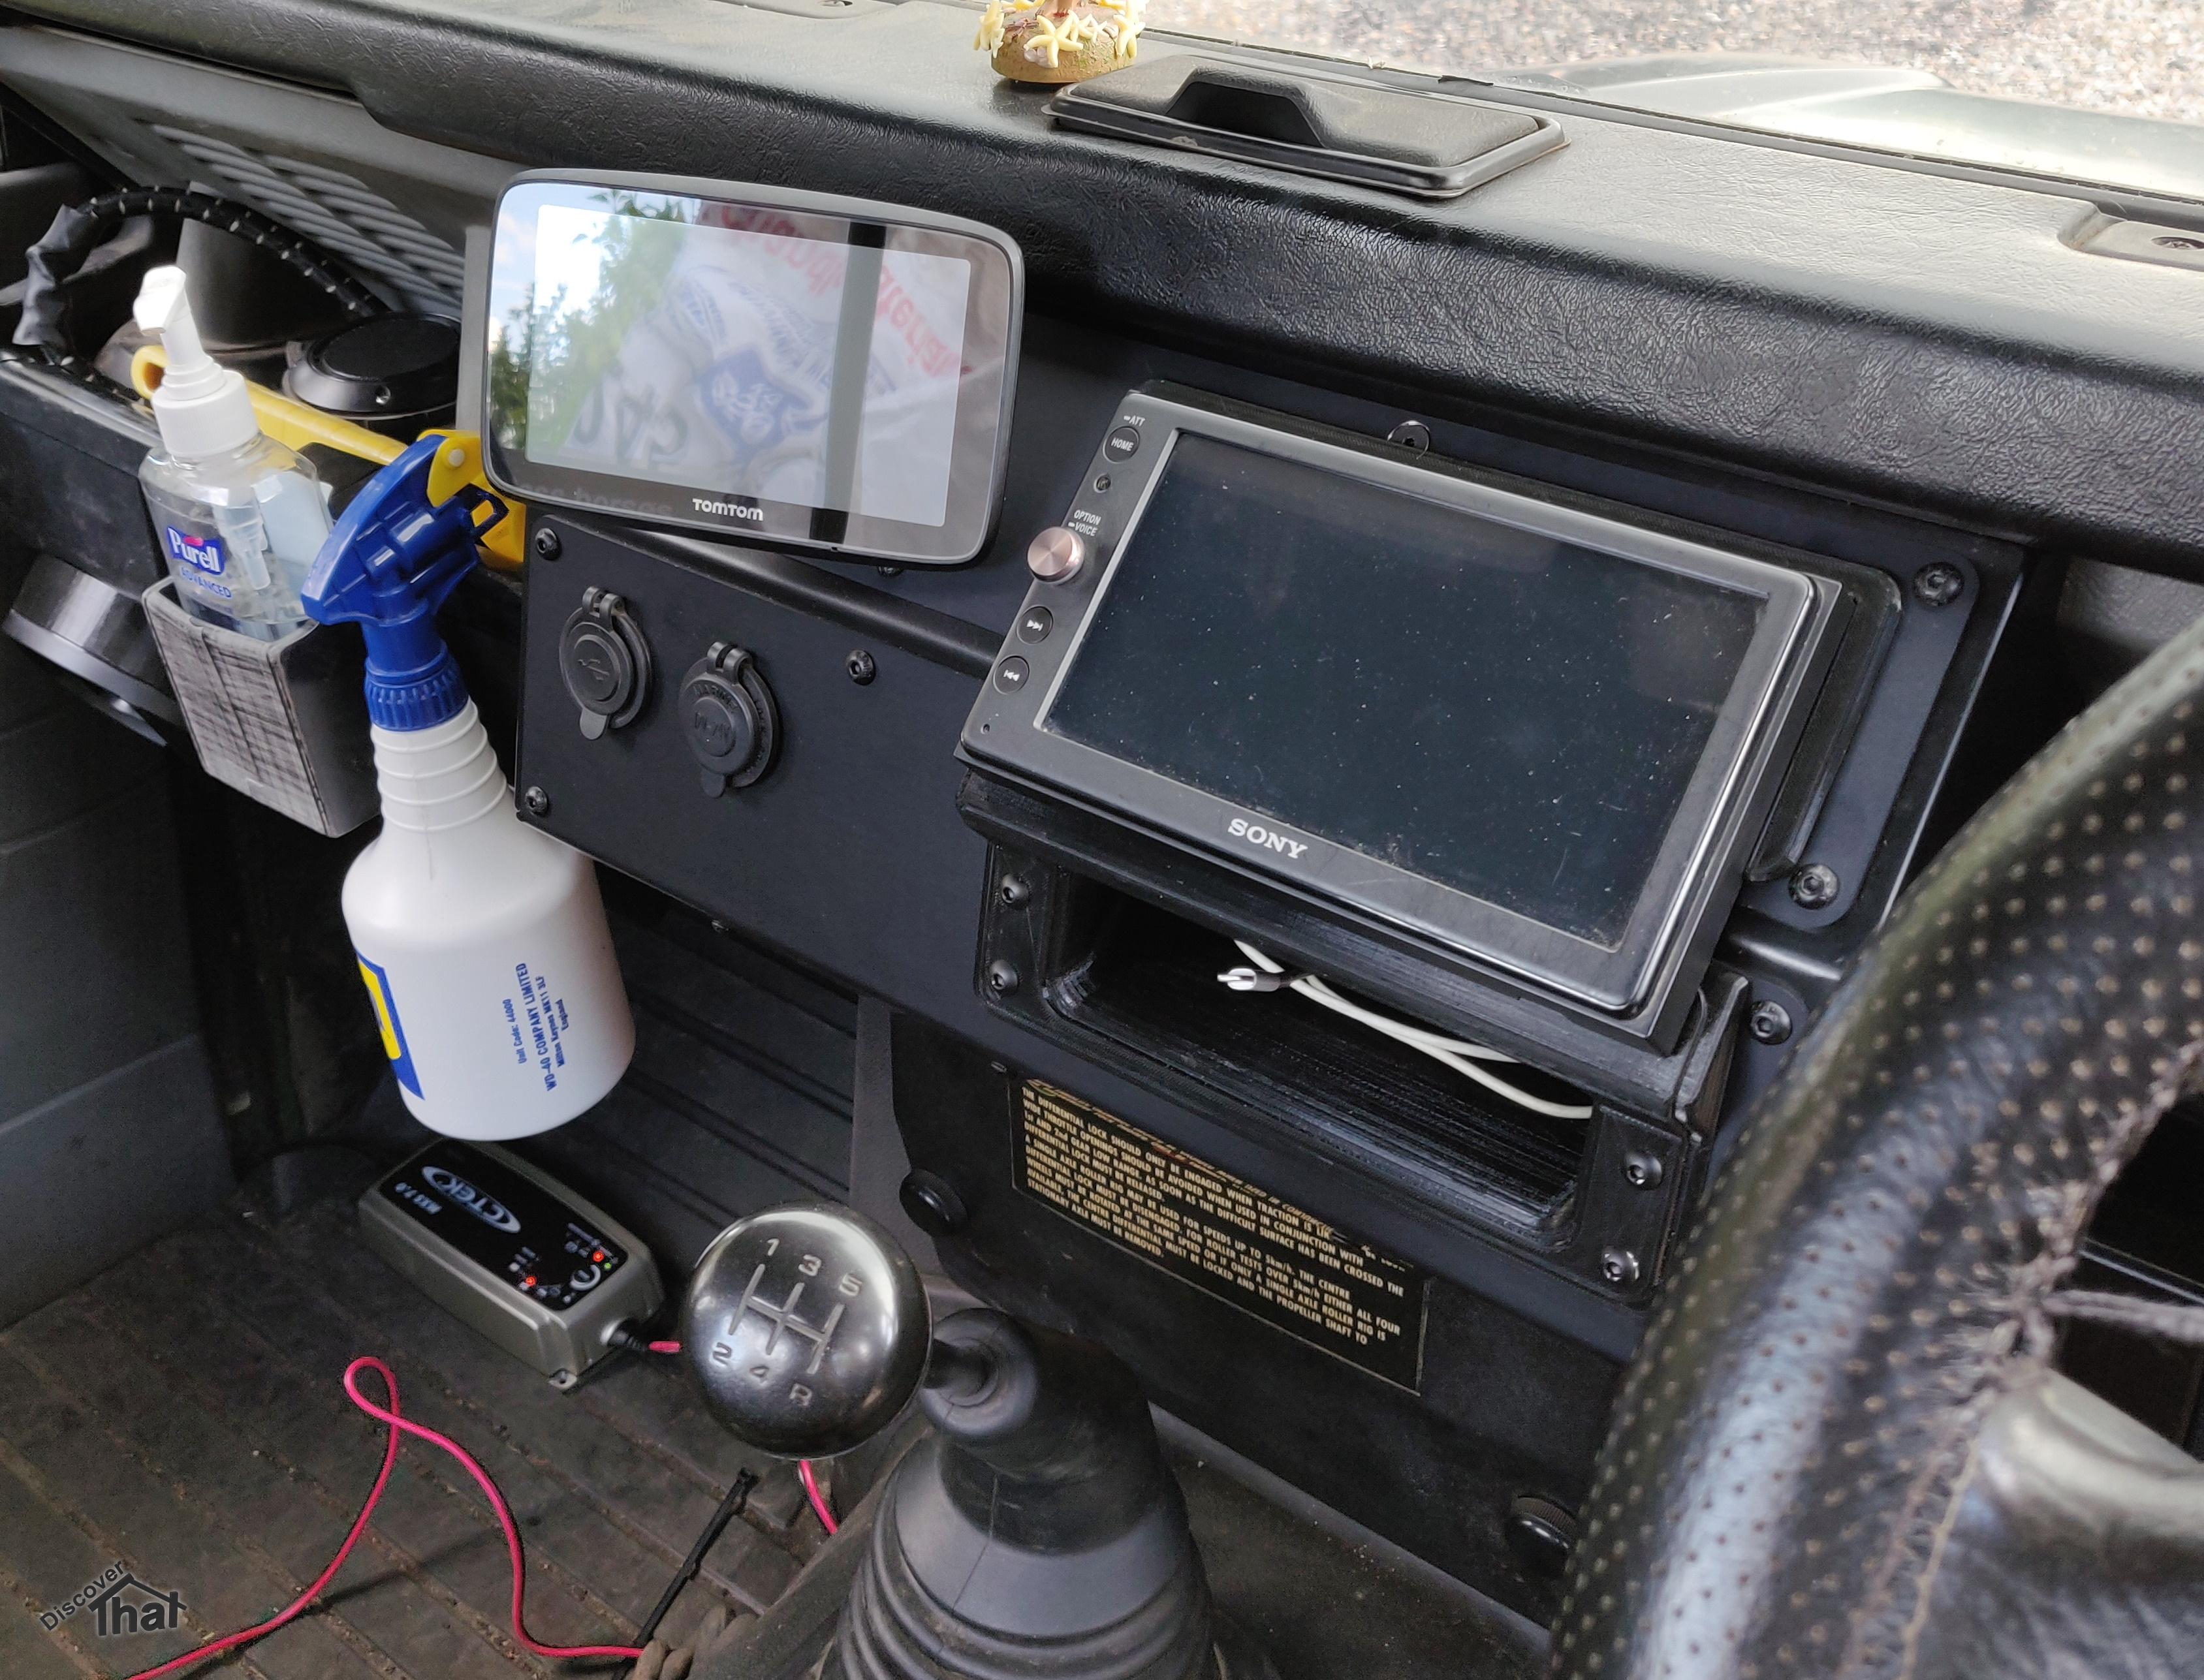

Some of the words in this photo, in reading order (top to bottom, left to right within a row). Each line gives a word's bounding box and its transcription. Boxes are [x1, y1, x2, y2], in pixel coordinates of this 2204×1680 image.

[1129, 415, 1146, 427] ATT
[1111, 437, 1133, 452] HOME
[1074, 509, 1101, 525] OPTION
[1075, 523, 1097, 537] VOICE
[168, 527, 221, 573] Purell
[1227, 818, 1308, 859] SONY
[516, 963, 536, 1005] LIMITED
[539, 991, 552, 1014] MK11
[511, 1024, 523, 1047] Code:
[527, 1006, 549, 1056] COMPANY
[547, 1014, 559, 1042] Keynes
[555, 998, 569, 1031] England
[516, 1047, 527, 1064] Unit
[540, 1056, 557, 1091] WD-40
[1022, 1087, 1035, 1101] THE
[1037, 1095, 1084, 1128] DIFFERENTIAL
[1088, 1123, 1107, 1140] LOCK
[1110, 1134, 1141, 1157] SHOULD
[1145, 1151, 1166, 1168] ONLY
[1170, 1162, 1180, 1175] BE
[1184, 1169, 1222, 1193] ENGAGED
[1226, 1187, 1252, 1206] WHEN
[1257, 1200, 1299, 1226] TRACTION
[1304, 1221, 1312, 1232] IS
[1024, 1120, 1069, 1153] DIFFERENTIAL
[1071, 1147, 1090, 1164] LOCK
[1092, 1158, 1112, 1176] MUST
[1114, 1170, 1124, 1182] BE
[1022, 1098, 1041, 1115] WIDE
[1043, 1110, 1077, 1136] THROTTLE
[1080, 1130, 1118, 1157] OPENINGS
[1120, 1151, 1152, 1172] SHOULD
[1154, 1167, 1164, 1179] BE
[1167, 1174, 1203, 1196] AVOIDED
[1206, 1190, 1232, 1209] WHEN
[1235, 1204, 1257, 1220] USED
[1259, 1214, 1270, 1226] IN
[1273, 1221, 1336, 1255] CONJUNCTION
[1339, 1248, 1363, 1267] WITH
[1025, 1134, 1030, 1143] A
[1033, 1138, 1057, 1159] SINGLE
[1060, 1153, 1077, 1170] AXLE
[1080, 1164, 1107, 1185] ROLLER
[1109, 1180, 1124, 1194] RIG
[1127, 1189, 1144, 1204] MAY
[1147, 1198, 1156, 1210] BE
[1159, 1204, 1180, 1221] USED
[1183, 1215, 1199, 1231] FOR
[1203, 1225, 1231, 1245] SPEEDS
[1235, 1239, 1246, 1251] UP
[1250, 1247, 1261, 1259] TO
[1299, 1269, 1314, 1284] THE
[1318, 1279, 1349, 1300] CENTRE
[1027, 1177, 1069, 1208] STATIONARY
[1071, 1203, 1089, 1219] AXLE
[1090, 1213, 1111, 1230] MUST
[1113, 1225, 1122, 1237] BE
[1036, 1117, 1052, 1132] AND
[1070, 1136, 1090, 1154] GEAR
[1092, 1147, 1110, 1164] LOW
[1145, 1174, 1156, 1186] AS
[1159, 1181, 1182, 1198] SOON
[1185, 1193, 1196, 1205] AS
[1199, 1199, 1214, 1213] THE
[1217, 1207, 1255, 1232] DIFFICULT
[1259, 1226, 1294, 1249] SURFACE
[1297, 1243, 1315, 1258] HAS
[1319, 1252, 1340, 1269] BEEN
[1344, 1264, 1383, 1287] CROSSED
[1387, 1281, 1404, 1297] THE
[1026, 1144, 1071, 1177] DIFFERENTIAL
[1073, 1172, 1093, 1189] LOCK
[1095, 1183, 1116, 1201] MUST
[1120, 1196, 1129, 1207] BE
[1186, 1228, 1203, 1243] FOR
[1206, 1238, 1236, 1259] ROLLER
[1240, 1254, 1262, 1271] TESTS
[1266, 1266, 1289, 1284] OVER
[1323, 1293, 1353, 1314] EITHER
[1357, 1308, 1372, 1322] ALL
[1376, 1316, 1400, 1335] FOUR
[1026, 1156, 1052, 1177] WHEELS
[1054, 1172, 1075, 1189] MUST
[1077, 1185, 1086, 1196] BE
[1089, 1190, 1120, 1213] ROTATED
[1124, 1209, 1133, 1220] AT
[1135, 1215, 1150, 1229] THE
[1153, 1223, 1174, 1241] SAME
[1178, 1236, 1201, 1253] SPEED
[1204, 1249, 1216, 1261] OR
[1220, 1256, 1227, 1266] IF
[1231, 1262, 1252, 1278] ONLY
[1255, 1273, 1262, 1283] A
[1266, 1278, 1294, 1298] SINGLE
[1297, 1294, 1318, 1310] AXLE
[1322, 1304, 1353, 1326] ROLLER
[1357, 1320, 1374, 1335] RIG
[1377, 1330, 1385, 1341] IS
[766, 1237, 779, 1256] 1
[798, 1254, 822, 1277] 3
[838, 1272, 862, 1297] 5
[1067, 1189, 1080, 1204] THE
[1082, 1198, 1109, 1219] CENTRE
[1112, 1213, 1162, 1246] DIFFERENTIAL
[1165, 1240, 1187, 1258] MUST
[1190, 1252, 1199, 1264] BE
[1203, 1259, 1233, 1280] LOCKED
[1236, 1276, 1255, 1291] AND
[1258, 1286, 1272, 1300] THE
[1276, 1294, 1321, 1324] PROPELLER
[1325, 1318, 1351, 1337] SHAFT
[1355, 1331, 1367, 1345] TO
[712, 1342, 732, 1368] 2
[750, 1365, 770, 1384] 4
[789, 1383, 813, 1407] R
